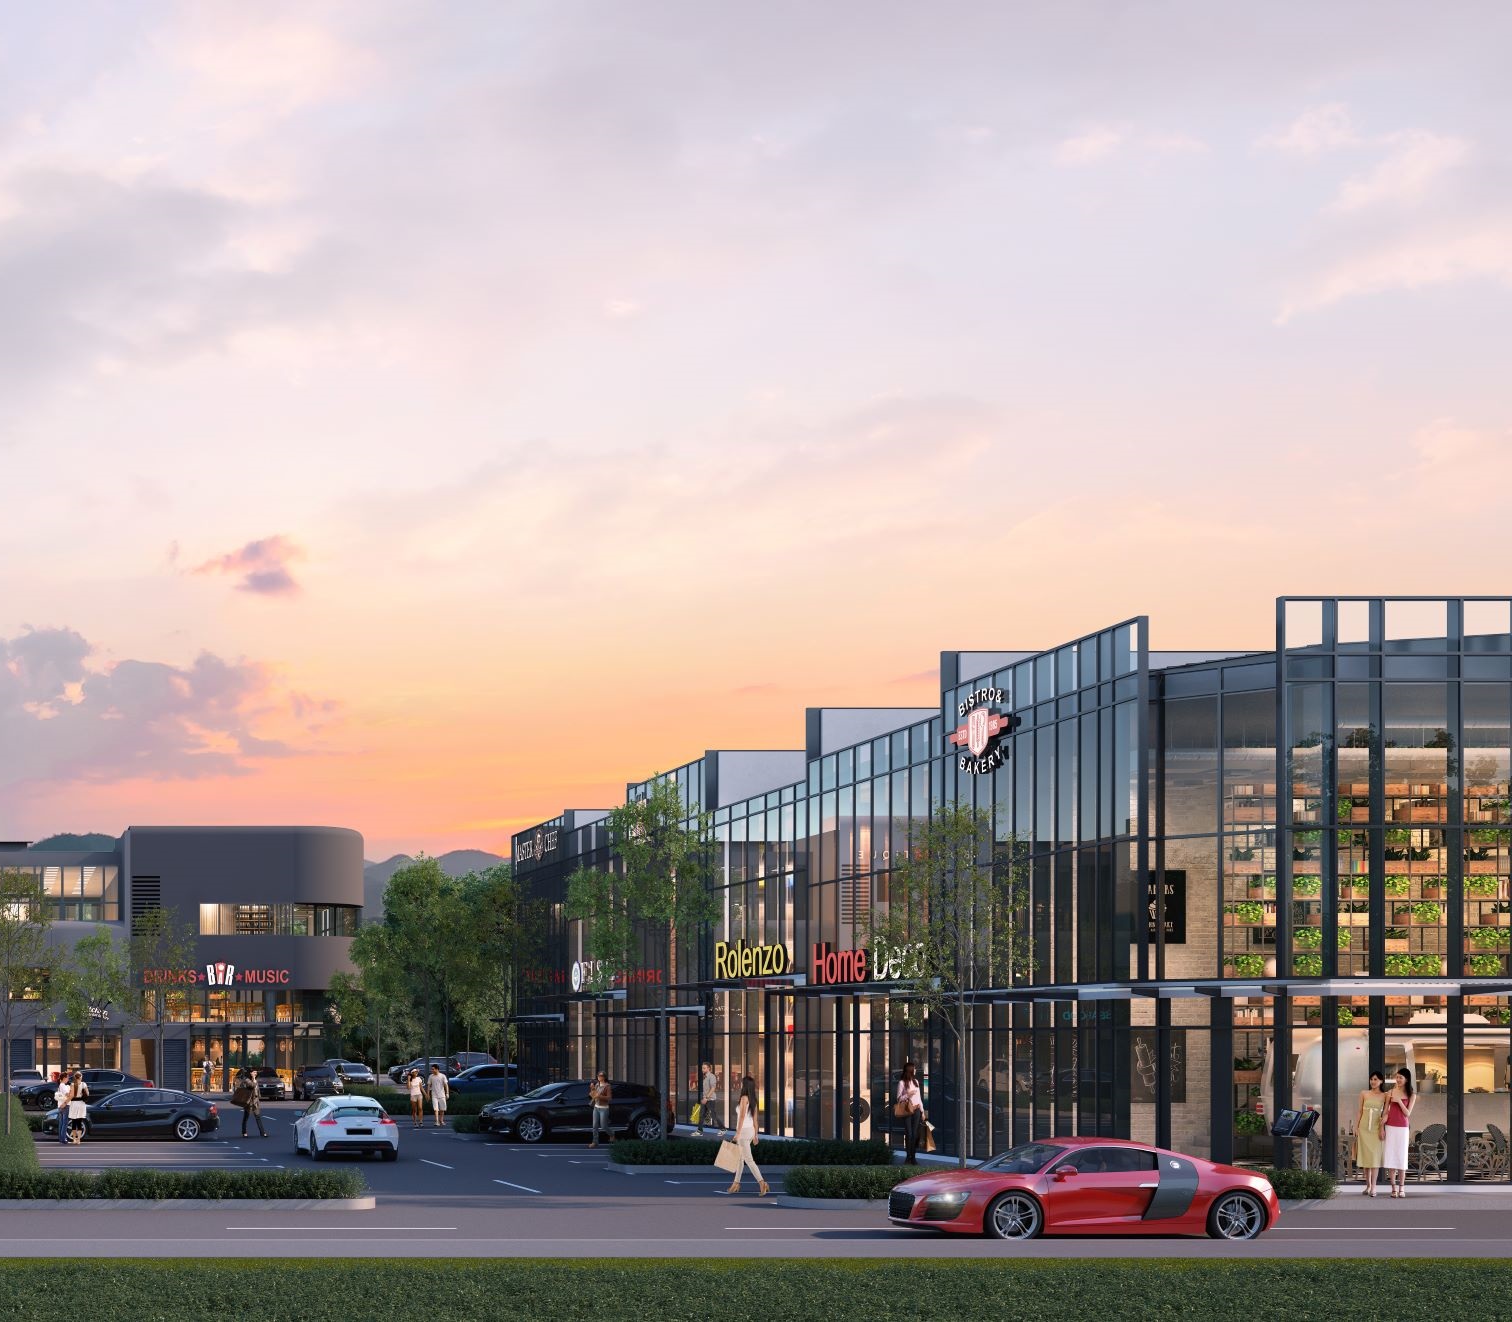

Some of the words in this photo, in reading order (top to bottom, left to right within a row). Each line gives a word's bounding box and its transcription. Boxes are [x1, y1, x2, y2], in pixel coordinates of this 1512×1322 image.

[959, 745, 1001, 775] BAKERY
[143, 969, 197, 985] DRINKS
[206, 963, 235, 986] BAR
[244, 969, 289, 984] MUSIC
[715, 939, 784, 979] Rolenzo
[812, 942, 866, 985] Home
